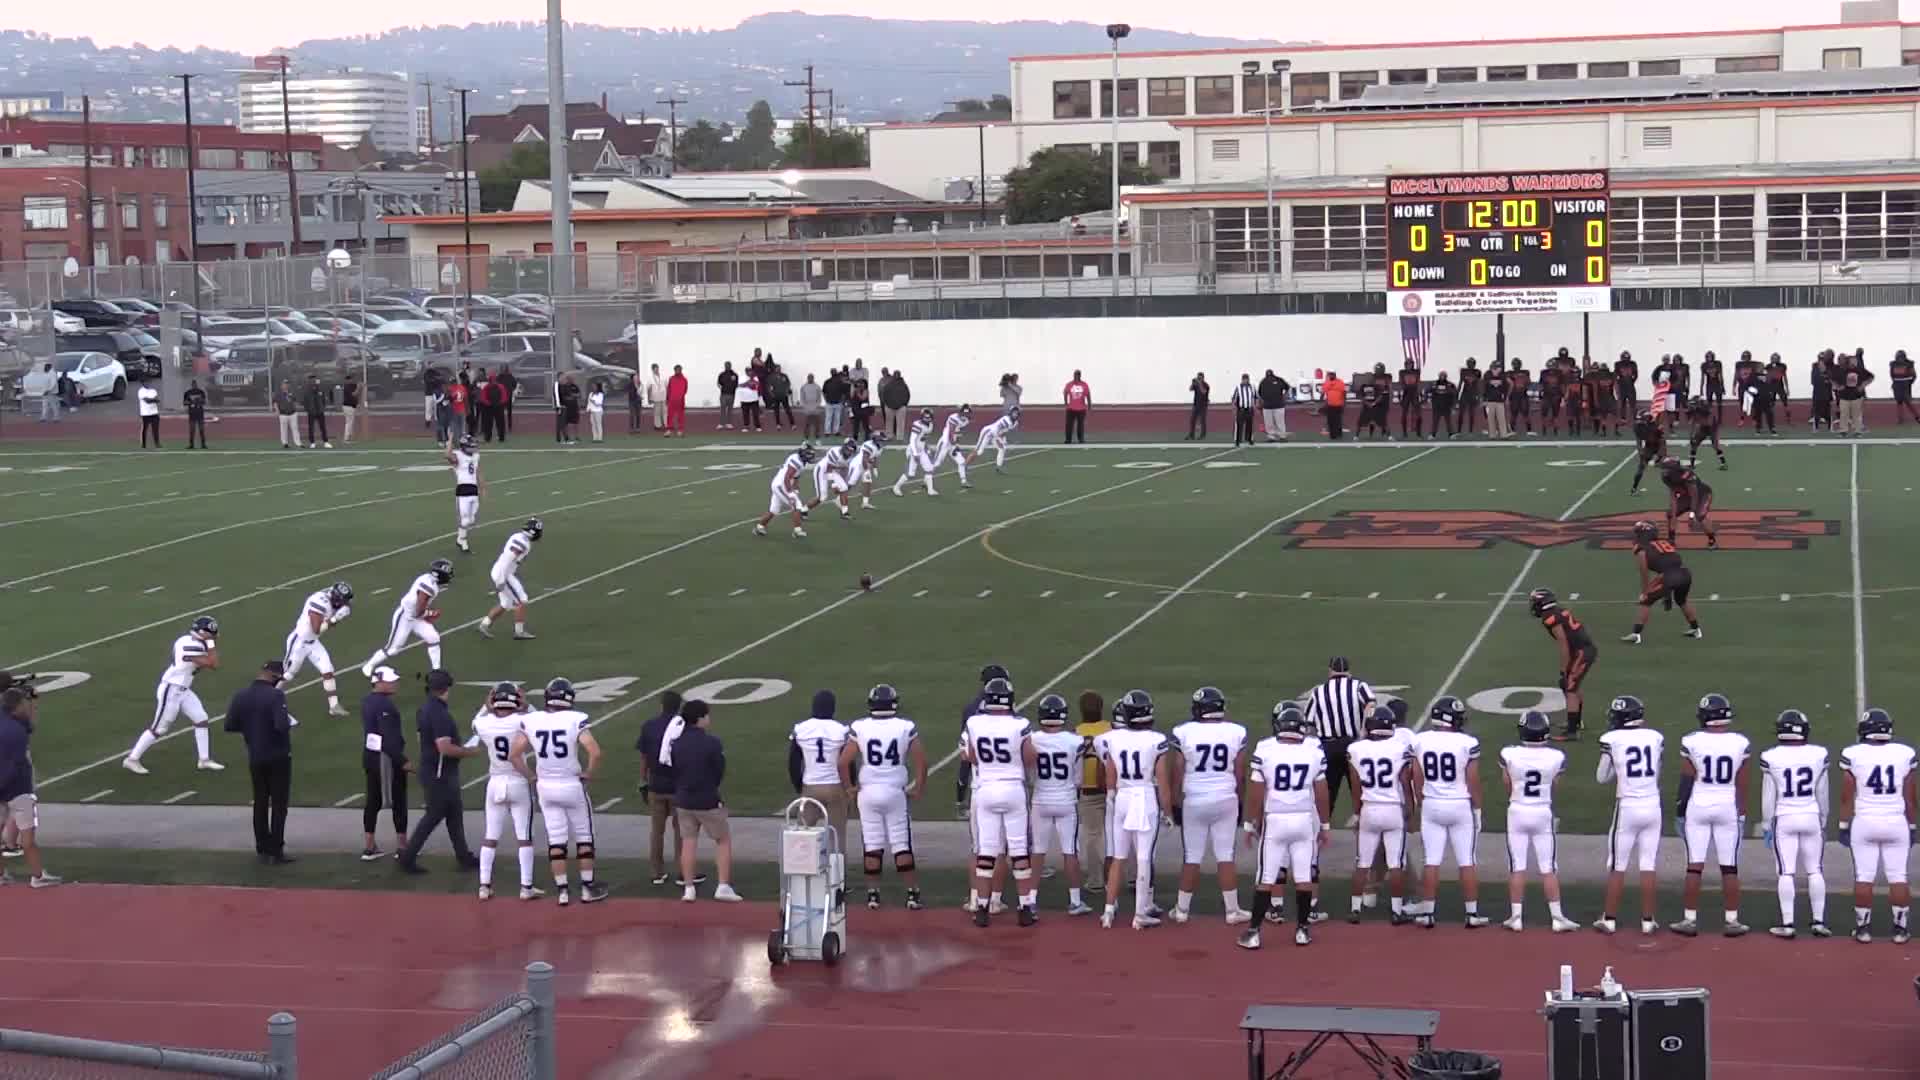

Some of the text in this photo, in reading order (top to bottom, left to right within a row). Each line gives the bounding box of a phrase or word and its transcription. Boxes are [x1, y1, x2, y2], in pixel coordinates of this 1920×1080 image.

[1390, 173, 1605, 194] MCCLYMONDS WARRIORS
[1394, 204, 1435, 218] HOME
[1468, 200, 1537, 228] 12:00
[1554, 200, 1606, 214] VISITOR
[1410, 225, 1427, 252] 0
[1443, 234, 1455, 252] 3
[1513, 234, 1520, 252] 1
[1540, 231, 1552, 250] 3
[1586, 220, 1603, 247] 0
[1393, 260, 1409, 287] 0
[1411, 267, 1445, 280] DOWN
[1470, 258, 1487, 285] 0
[1550, 263, 1567, 277] ON
[1586, 256, 1603, 283] 0
[1516, 297, 1558, 305] Together
[493, 735, 509, 761] 9
[535, 729, 569, 759] 75
[815, 738, 827, 763] 1
[866, 738, 901, 767] 64
[976, 736, 1012, 764] 65
[1037, 750, 1070, 781] 85
[1119, 750, 1144, 781] 11
[1194, 743, 1229, 773] 79
[1422, 751, 1457, 783] 88
[1625, 745, 1656, 778] 21
[1701, 755, 1733, 785] 10
[1273, 763, 1310, 792] 87
[1359, 757, 1394, 789] 32
[1523, 770, 1542, 798] 2
[1782, 766, 1813, 798] 12
[1865, 765, 1897, 795] 41
